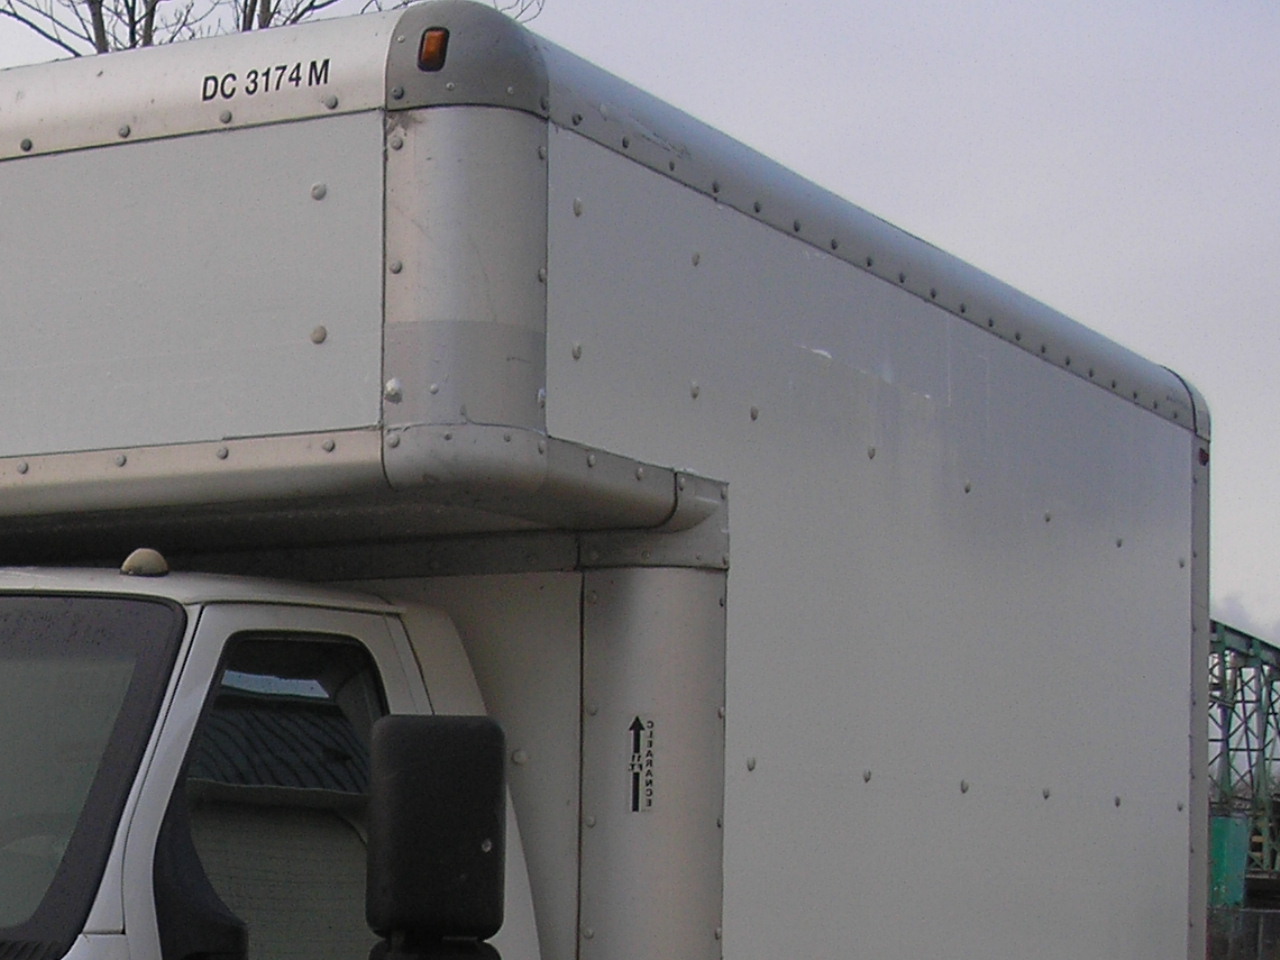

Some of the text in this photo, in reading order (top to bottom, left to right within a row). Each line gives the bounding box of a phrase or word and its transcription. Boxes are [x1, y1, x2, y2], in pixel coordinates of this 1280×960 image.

[202, 58, 330, 101] DC 3174 M
